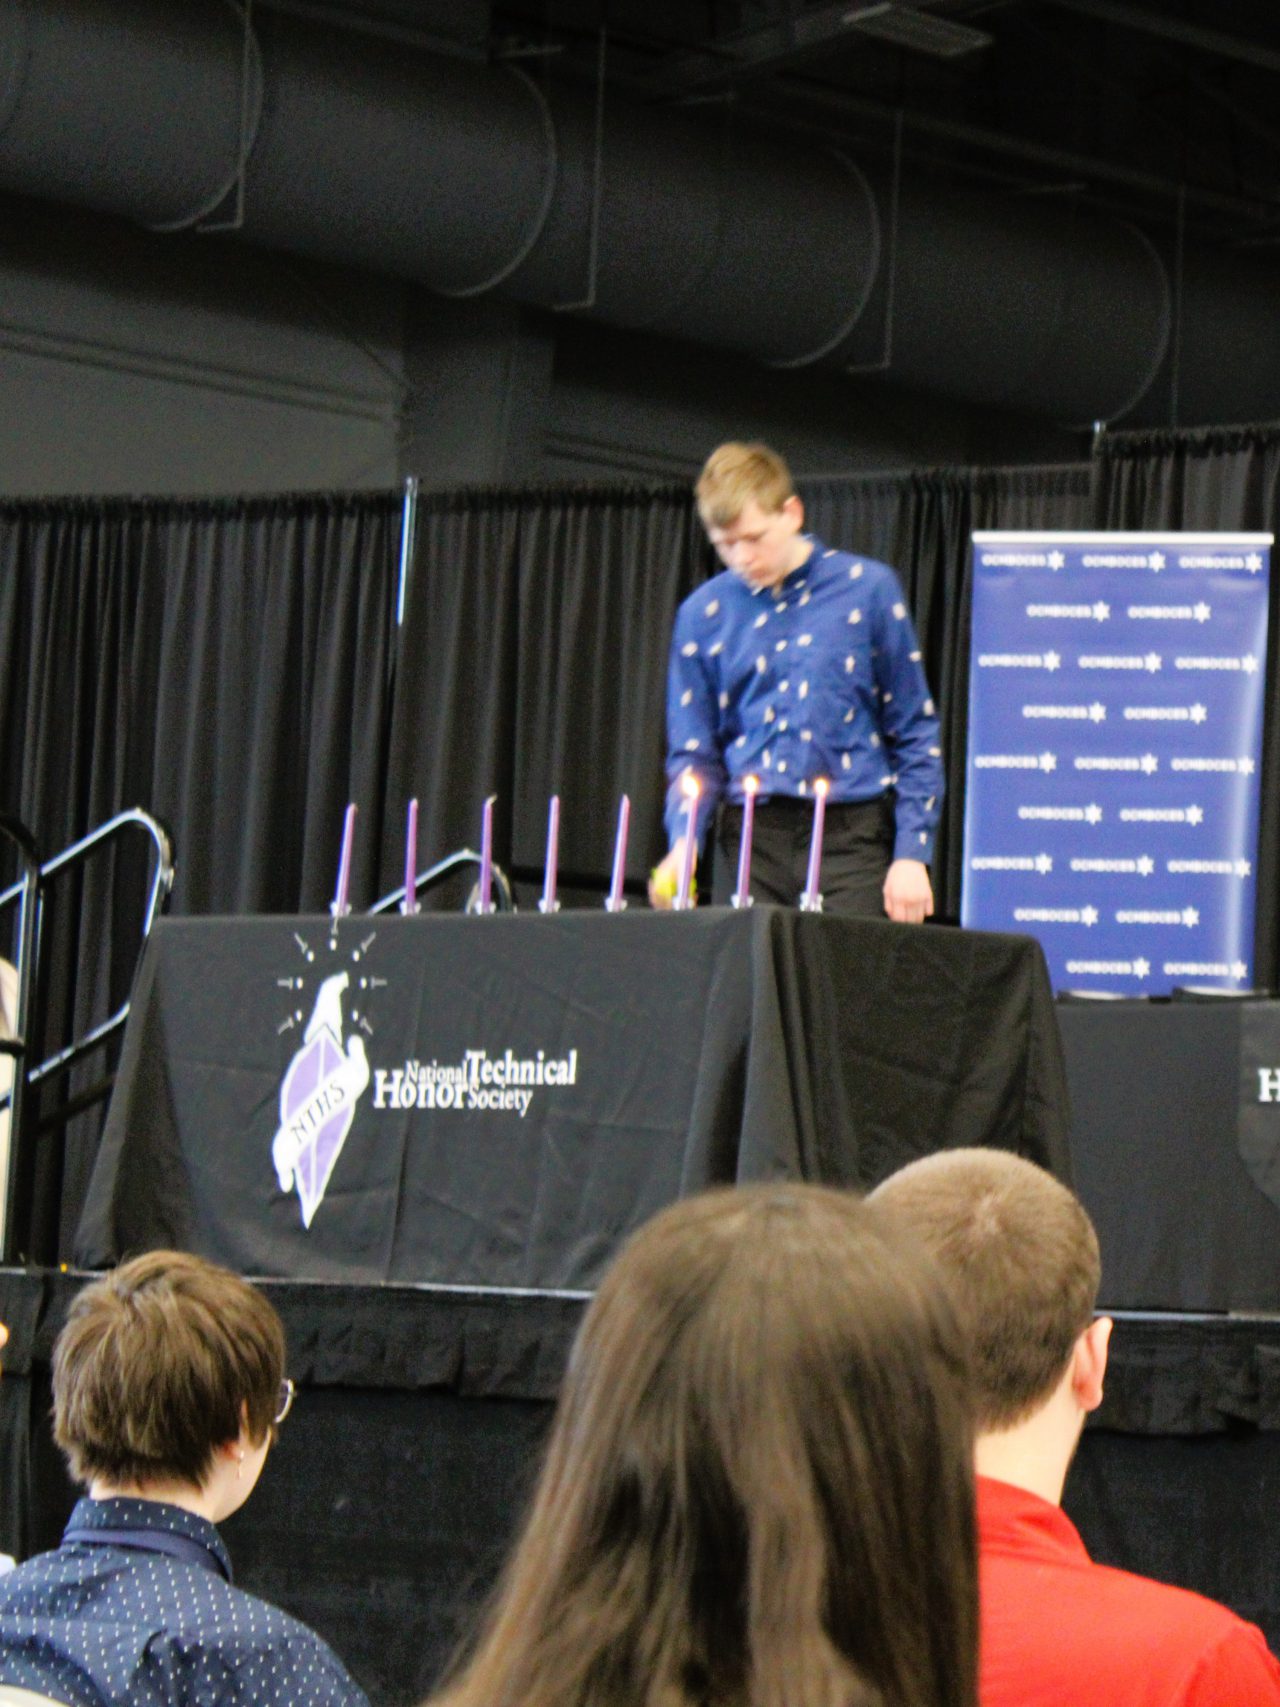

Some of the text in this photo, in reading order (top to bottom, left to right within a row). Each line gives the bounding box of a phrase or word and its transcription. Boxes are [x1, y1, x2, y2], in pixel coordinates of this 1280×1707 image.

[406, 1049, 578, 1085] National Technical
[290, 1083, 345, 1144] NTHS
[372, 1069, 534, 1118] Honor Society
